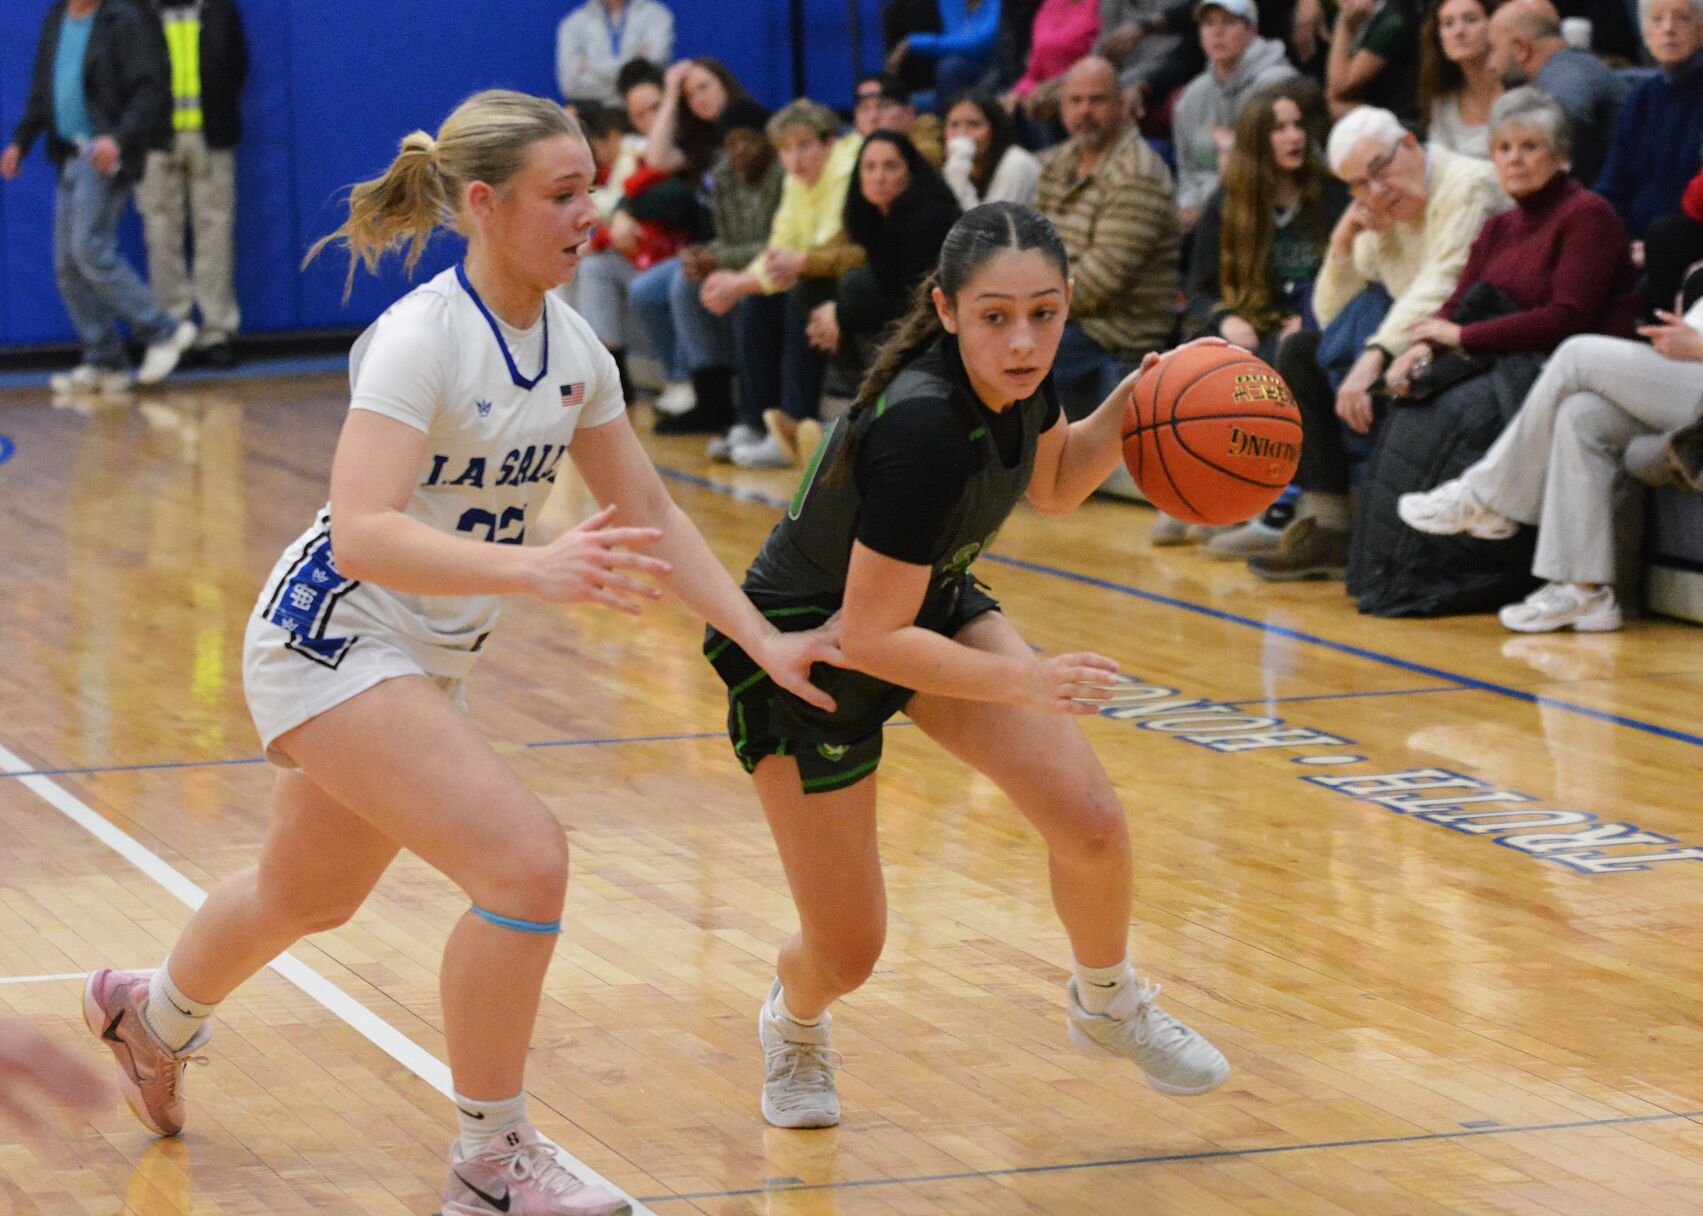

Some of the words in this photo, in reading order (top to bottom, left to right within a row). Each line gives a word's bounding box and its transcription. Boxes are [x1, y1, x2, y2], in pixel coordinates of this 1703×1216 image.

[420, 454, 486, 489] LA
[1078, 673, 1357, 753] HONO
[1297, 768, 1703, 877] TRUTH
